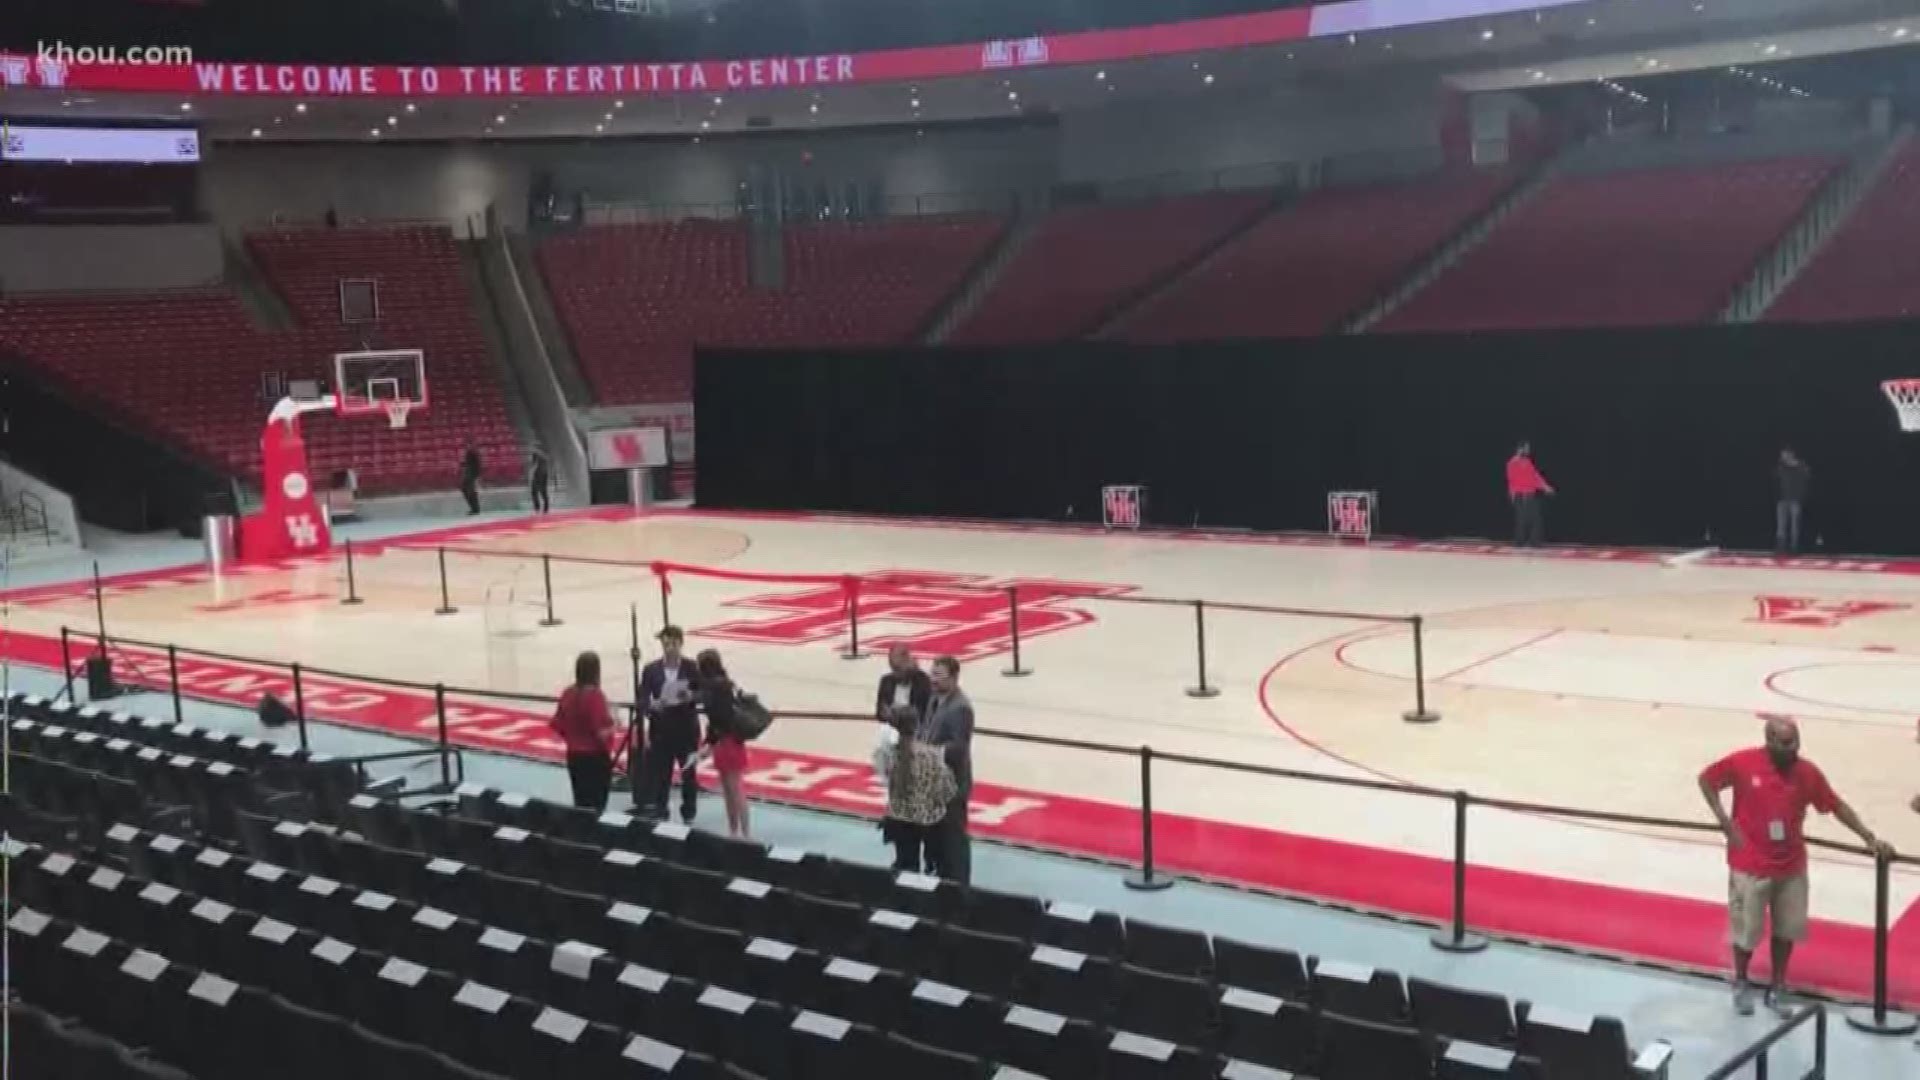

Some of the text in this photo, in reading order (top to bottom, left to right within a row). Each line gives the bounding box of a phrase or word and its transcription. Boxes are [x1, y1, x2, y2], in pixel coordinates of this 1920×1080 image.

[195, 53, 854, 93] WELCOME TO THE FERTITTA CENTER
